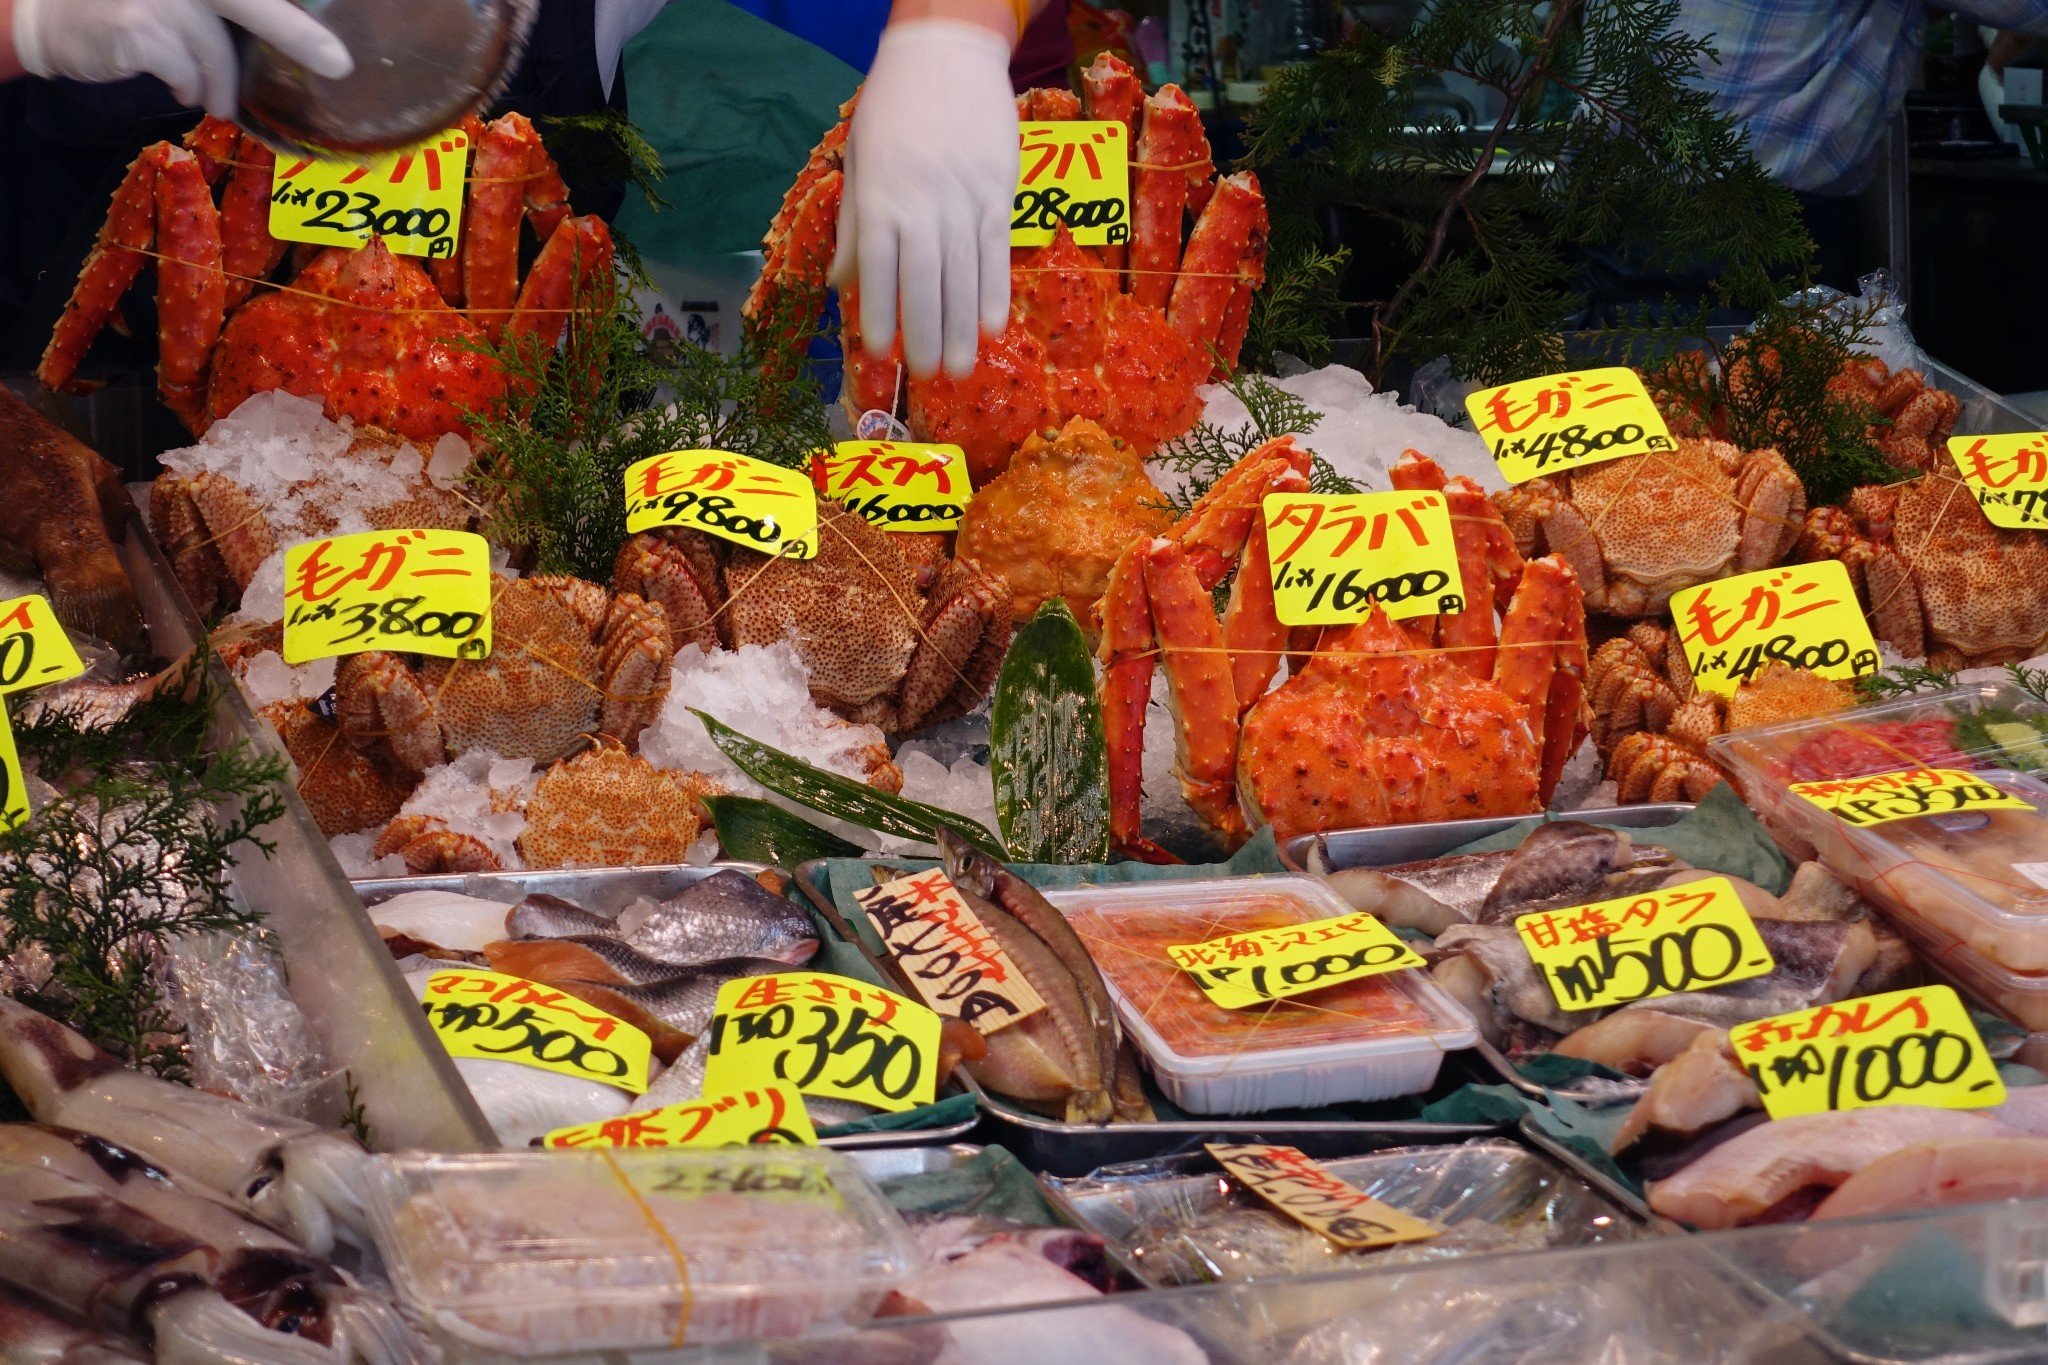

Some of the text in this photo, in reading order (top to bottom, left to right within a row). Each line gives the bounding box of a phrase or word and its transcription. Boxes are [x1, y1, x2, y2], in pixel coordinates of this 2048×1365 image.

[1020, 127, 1119, 185] ラバ
[1480, 377, 1638, 433] 毛ガニ
[626, 456, 802, 498] 毛ガニ
[1268, 496, 1440, 565] タラバ
[285, 530, 472, 602] 毛ガニ
[1682, 572, 1842, 646] 毛ガニ
